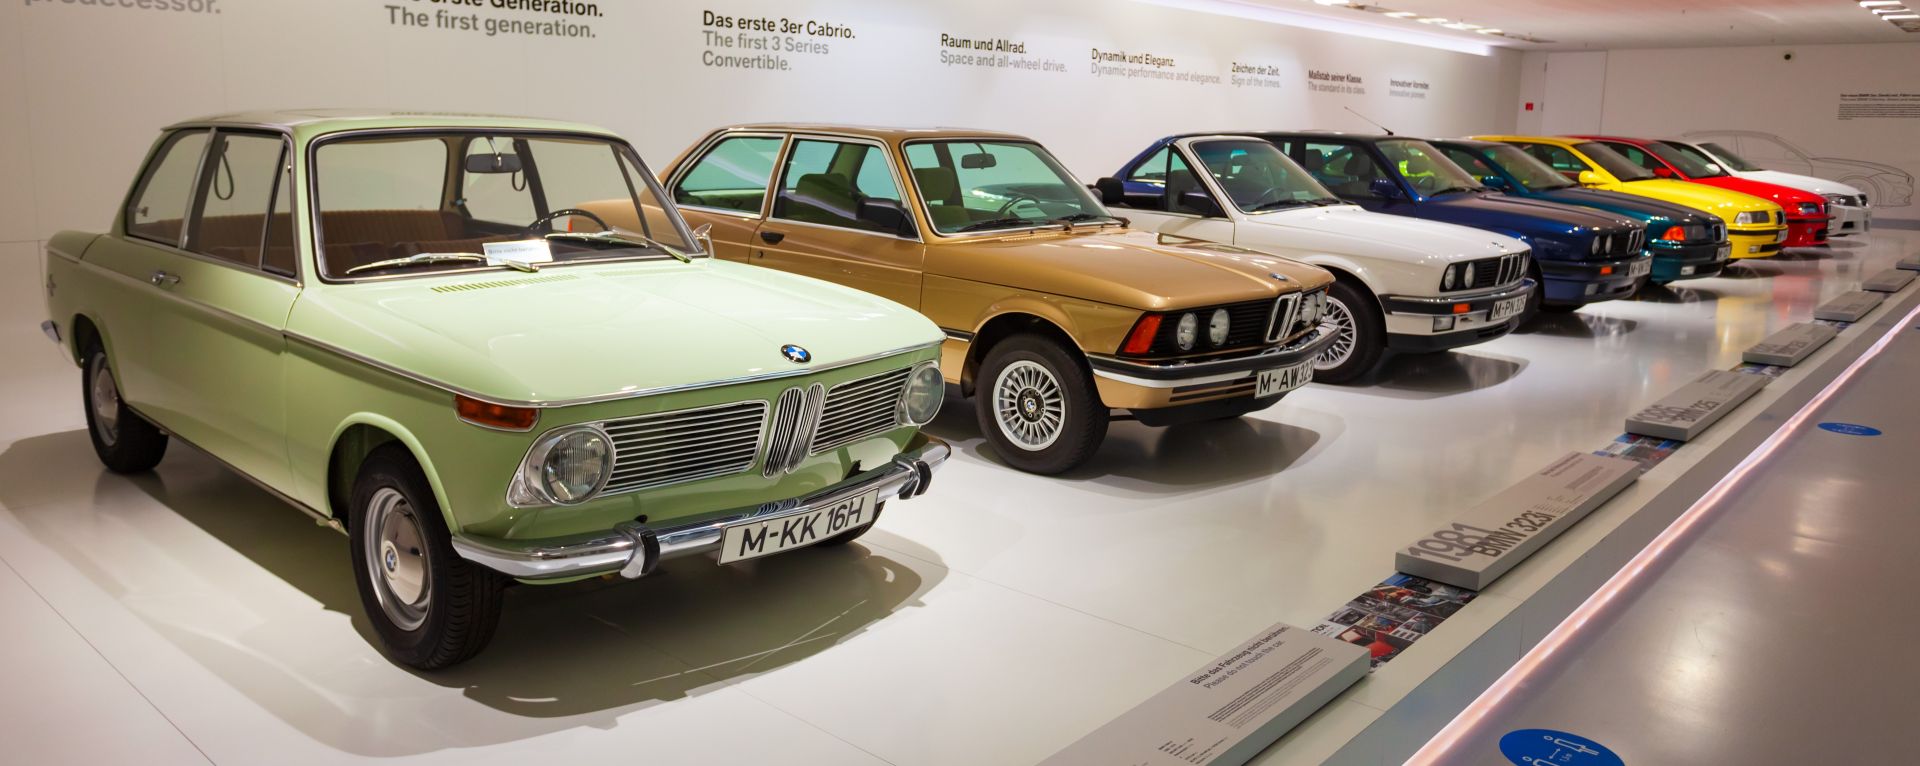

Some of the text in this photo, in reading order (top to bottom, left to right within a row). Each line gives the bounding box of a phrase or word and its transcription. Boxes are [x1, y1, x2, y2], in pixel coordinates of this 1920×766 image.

[385, 5, 596, 38] The first generation.
[703, 10, 856, 39] Das erste 3er Cabrio.
[702, 30, 829, 55] The first 3 Series
[941, 33, 1027, 54] Raum und Allrad.
[702, 50, 792, 71] Convertible.
[940, 49, 1068, 73] Space and all-wheel drive.
[1091, 48, 1176, 68] Dynamik und Eleganz.
[1231, 62, 1256, 73] Zeichen
[1091, 62, 1222, 85] Dynamic performance and elegance.
[1260, 359, 1314, 395] M-AW 323
[739, 497, 865, 557] M-KK 16H
[1468, 510, 1557, 558] BMW 323i
[1408, 522, 1498, 562] 1981
[1190, 673, 1211, 685] Bitte
[1208, 666, 1222, 675] das
[1218, 650, 1251, 668] Fahrzeug
[1203, 674, 1229, 689] Please
[1226, 668, 1238, 676] do
